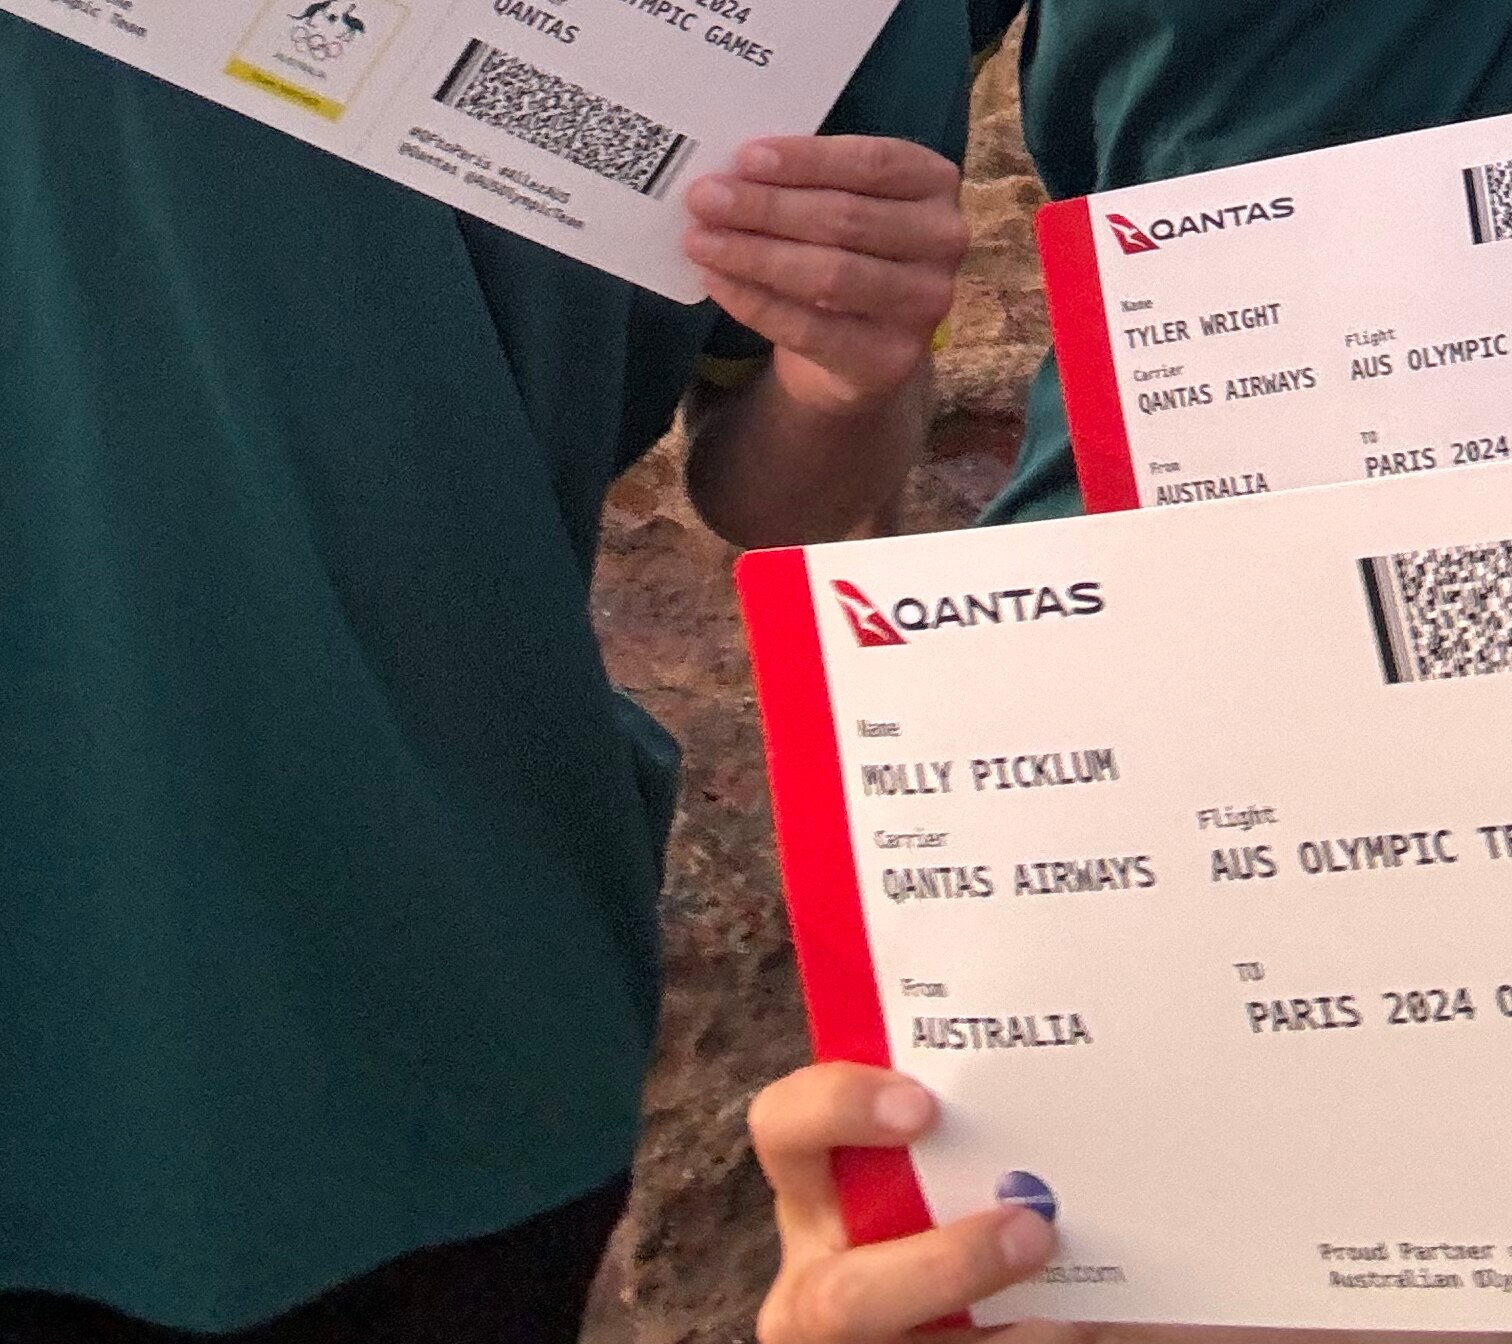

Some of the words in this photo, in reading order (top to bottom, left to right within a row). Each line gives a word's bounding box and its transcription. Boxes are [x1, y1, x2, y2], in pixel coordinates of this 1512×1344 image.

[704, 25, 774, 67] GAMES
[1149, 196, 1295, 242] QANTAS
[1123, 319, 1191, 349] TYLER
[1199, 302, 1281, 337] WRIGHT
[1344, 328, 1397, 348] Flight
[1132, 365, 1185, 383] Carrier
[1351, 353, 1394, 381] AUS
[1407, 333, 1509, 371] OLYMPIC
[1137, 383, 1214, 416] QANTAS
[1225, 366, 1317, 401] AIRWAYS
[1364, 447, 1438, 479] PARIS
[1450, 435, 1511, 466] 2024
[1156, 473, 1271, 506] AUSTRALIA
[894, 580, 1104, 631] QANTAS
[861, 760, 953, 796] MOLLY
[970, 748, 1120, 792] PICKLUM
[873, 829, 950, 850] Carrier
[1198, 806, 1278, 832] Flight
[1212, 845, 1277, 882] AUS
[1298, 830, 1458, 874] OLYMPIC
[882, 865, 995, 905] QANTAS
[1014, 855, 1156, 896] AIRWAYS
[914, 1013, 1093, 1050] AUSTRALIA
[1246, 995, 1362, 1033] PARIS
[1382, 988, 1476, 1025] 2024
[1317, 1243, 1389, 1261] Proud
[1397, 1243, 1495, 1260] Partner
[1329, 1268, 1463, 1288] Australian
